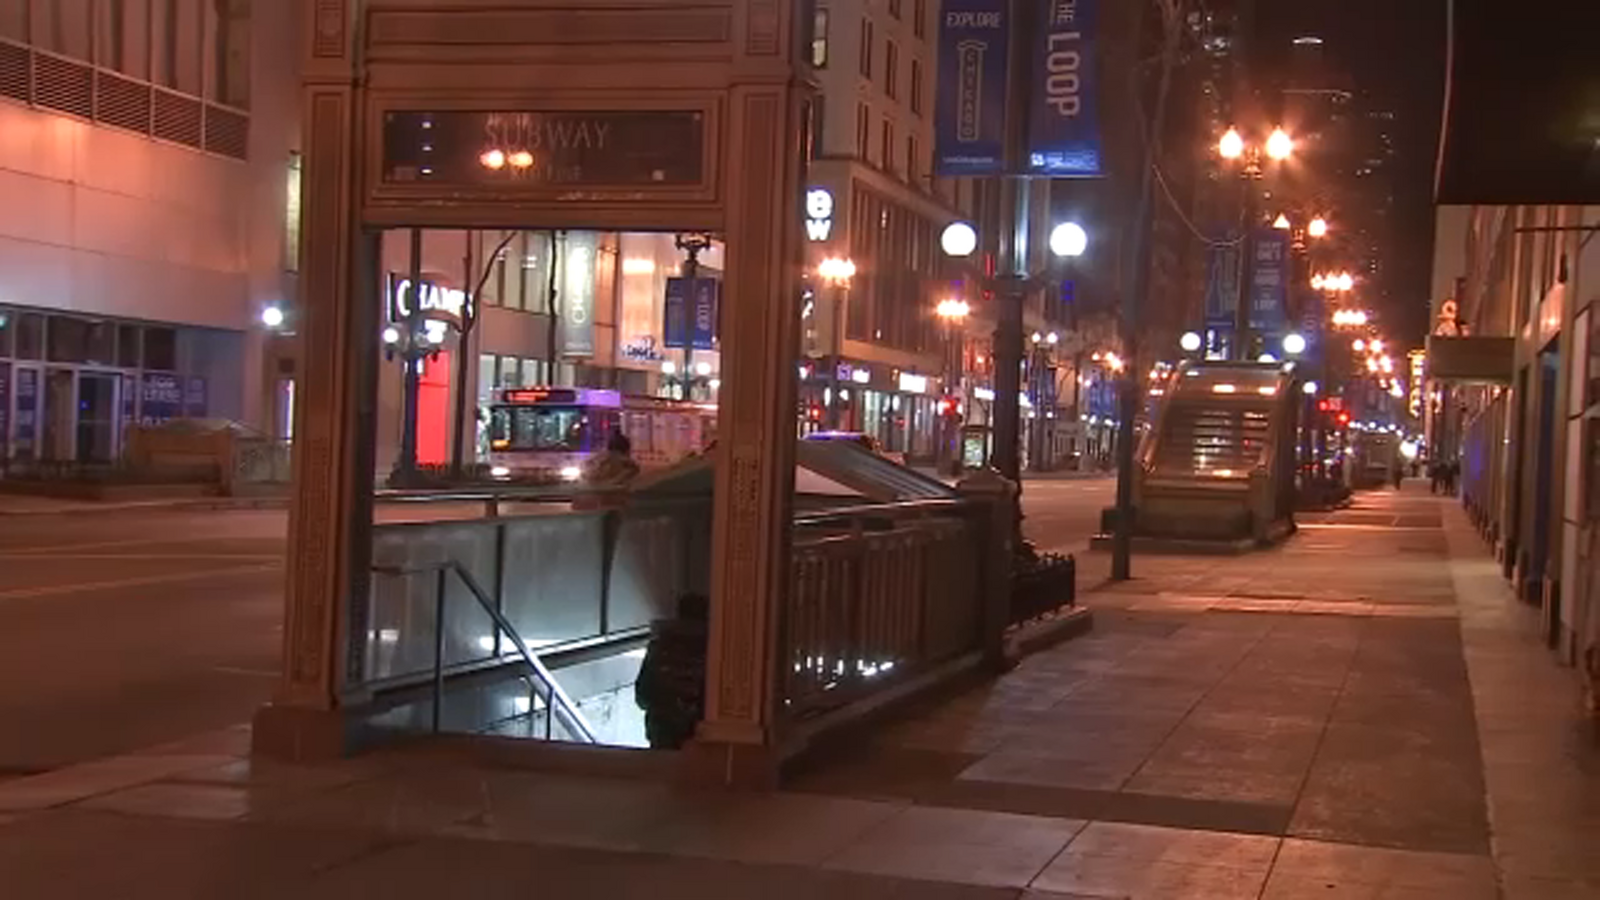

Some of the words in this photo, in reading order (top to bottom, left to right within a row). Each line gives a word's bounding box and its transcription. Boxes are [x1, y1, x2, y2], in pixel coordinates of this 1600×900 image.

[946, 11, 1001, 28] EXPLORE
[1046, 32, 1080, 116] LOOP
[484, 119, 610, 150] SUBWAY
